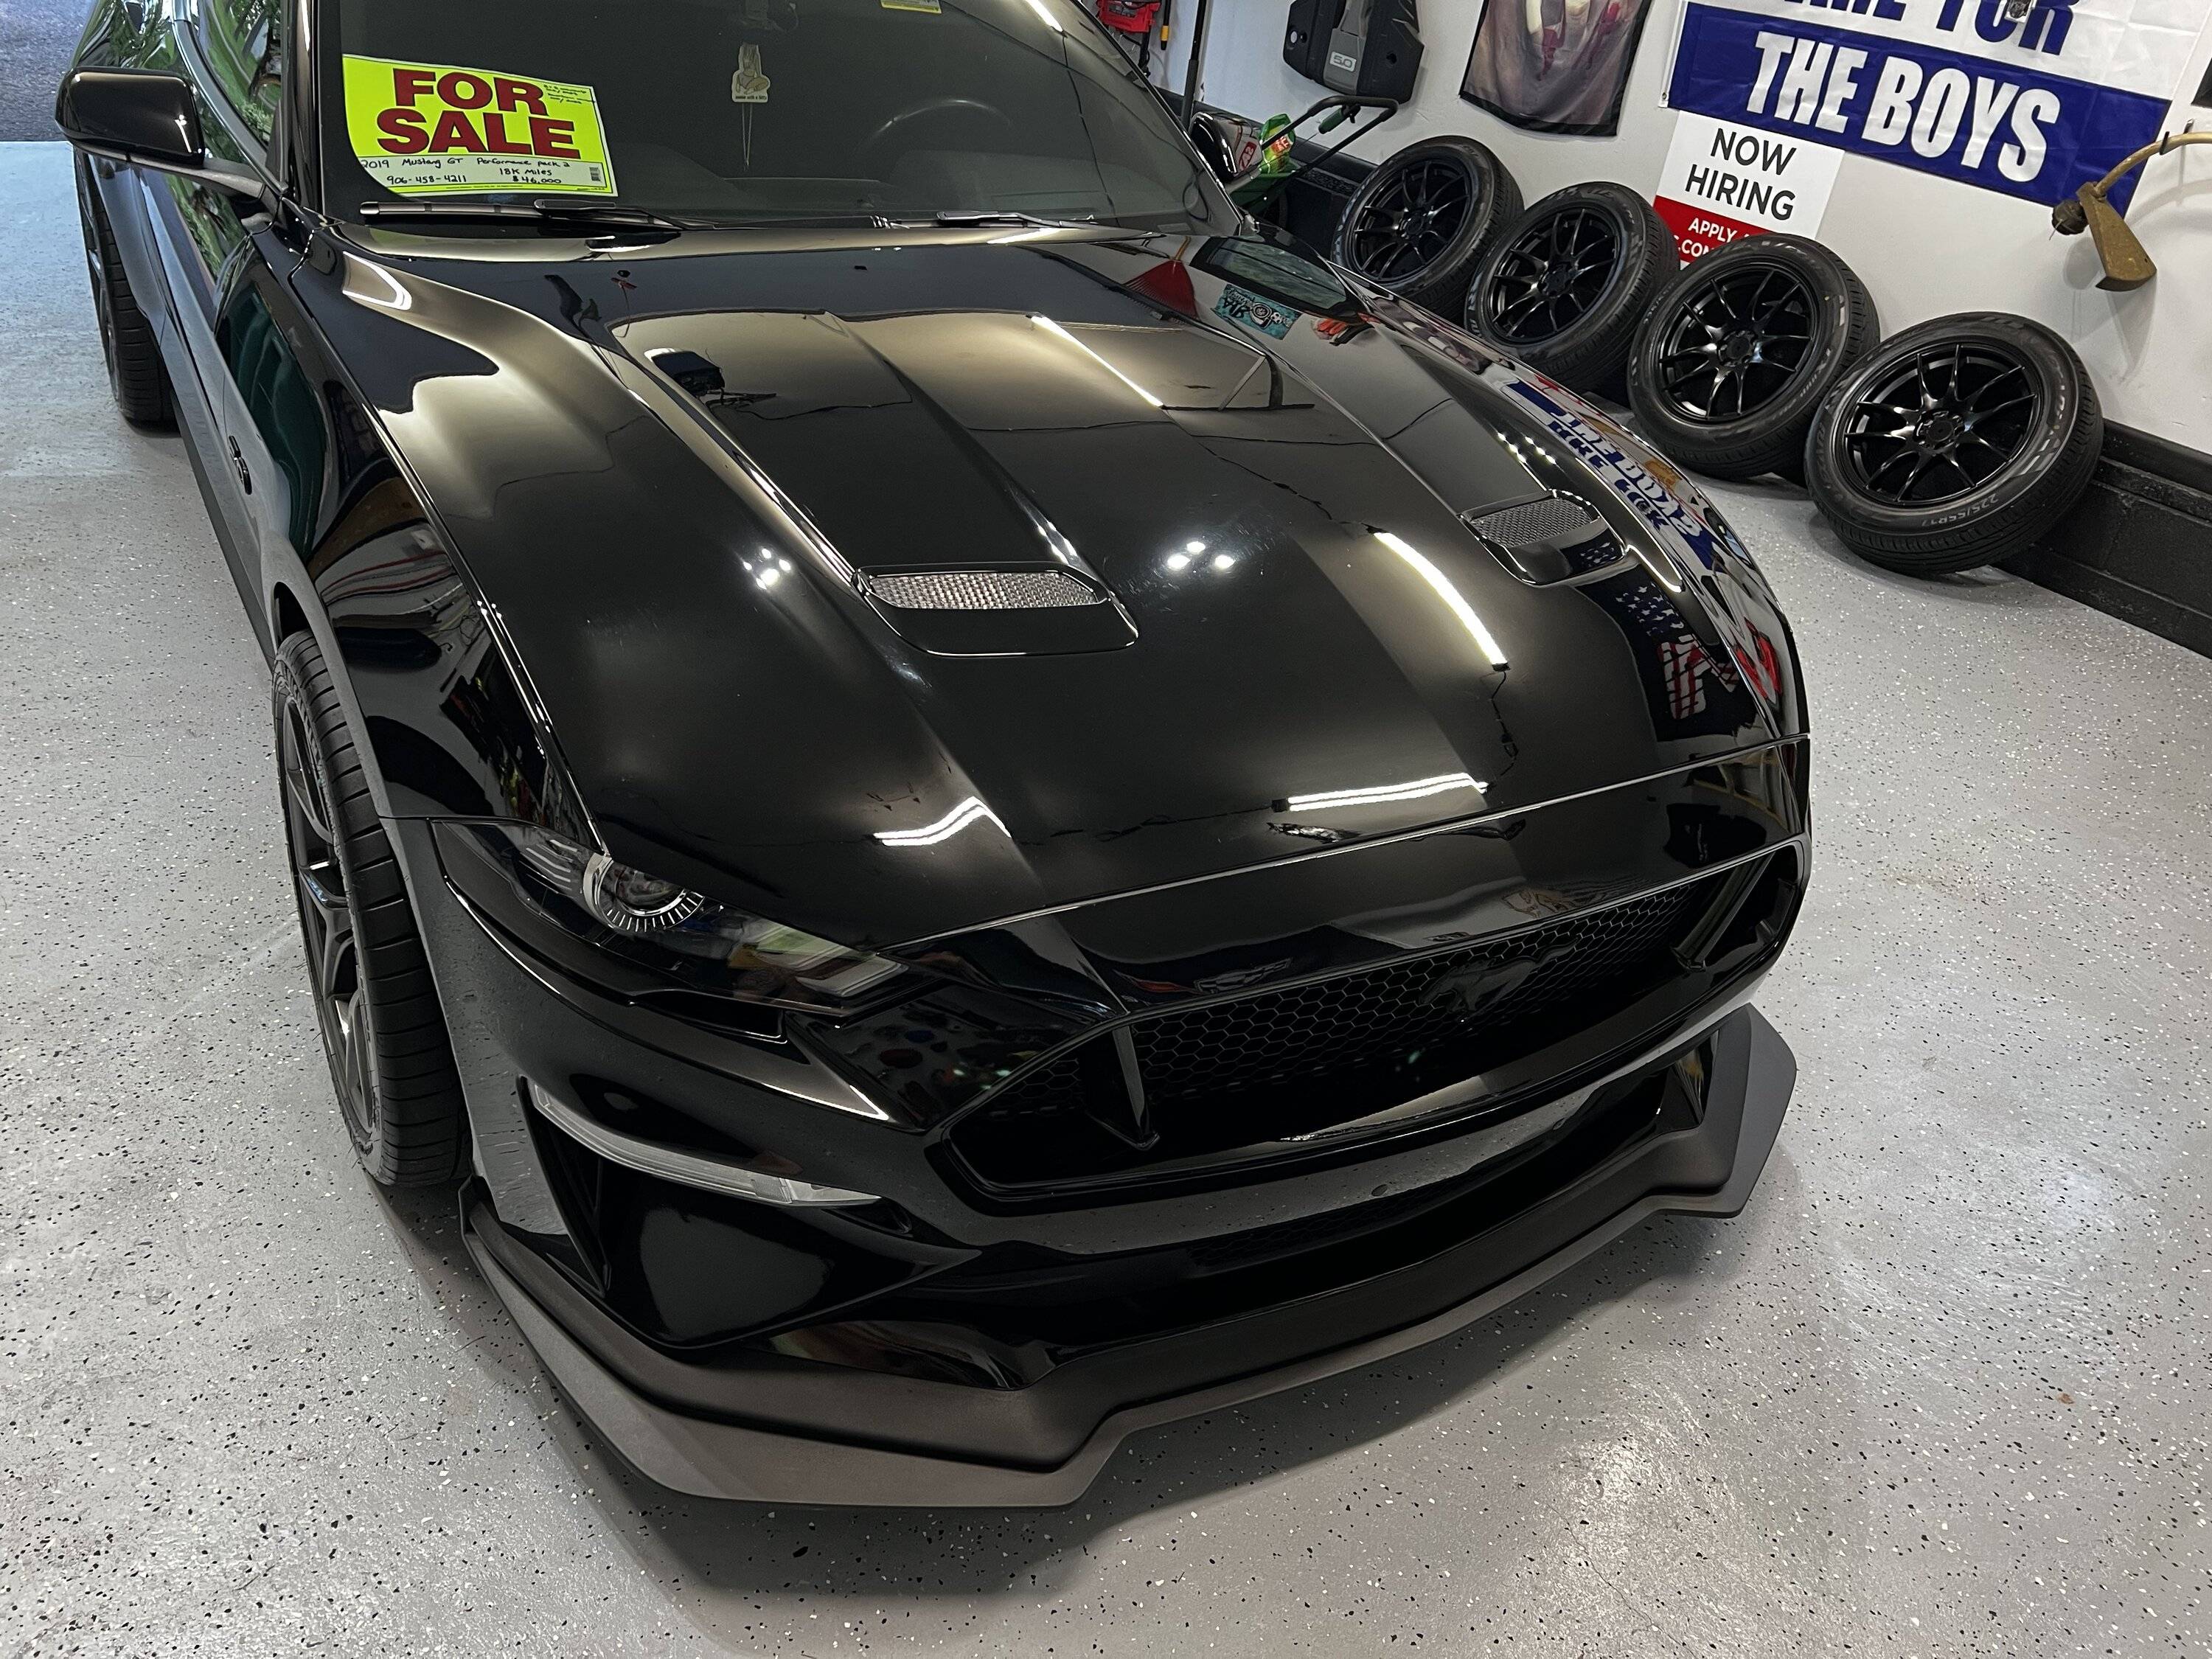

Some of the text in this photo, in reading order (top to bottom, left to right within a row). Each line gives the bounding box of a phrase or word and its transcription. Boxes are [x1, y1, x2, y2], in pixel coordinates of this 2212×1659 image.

[393, 68, 549, 116] FOR
[1746, 31, 2061, 183] THE BOYS
[377, 108, 581, 159] SALE
[1711, 128, 1797, 175] NOW
[361, 159, 389, 169] 2019
[402, 158, 442, 169] Mustang
[1685, 164, 1796, 220] HIRING
[1688, 218, 1738, 243] APPLY
